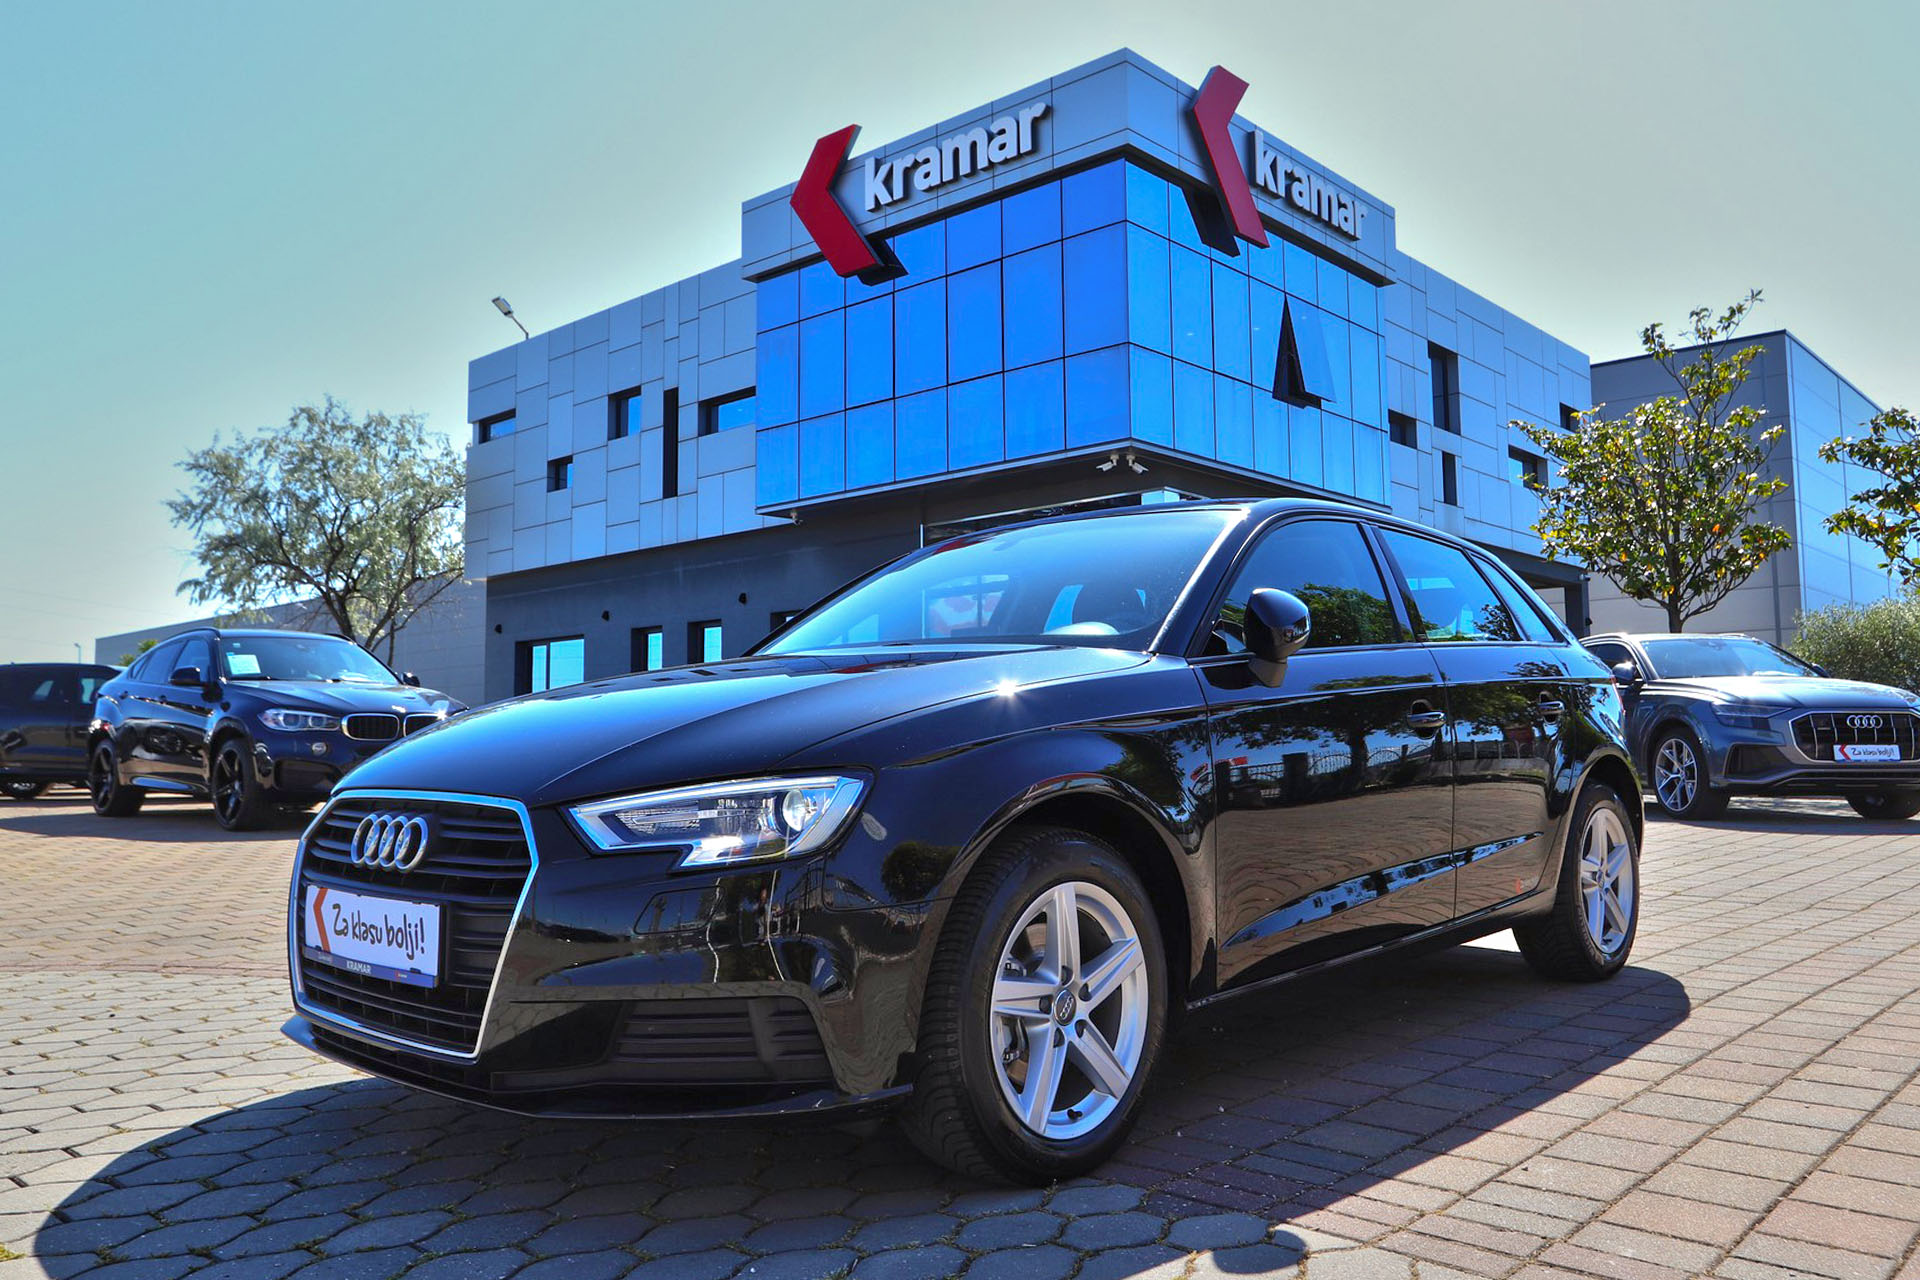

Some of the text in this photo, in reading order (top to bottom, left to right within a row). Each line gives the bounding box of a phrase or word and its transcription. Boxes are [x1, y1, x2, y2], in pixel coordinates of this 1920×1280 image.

[865, 102, 1047, 212] kramar
[1254, 129, 1369, 240] kramar
[332, 903, 425, 960] Za klasu bolji!
[346, 960, 372, 975] KRAMAR
